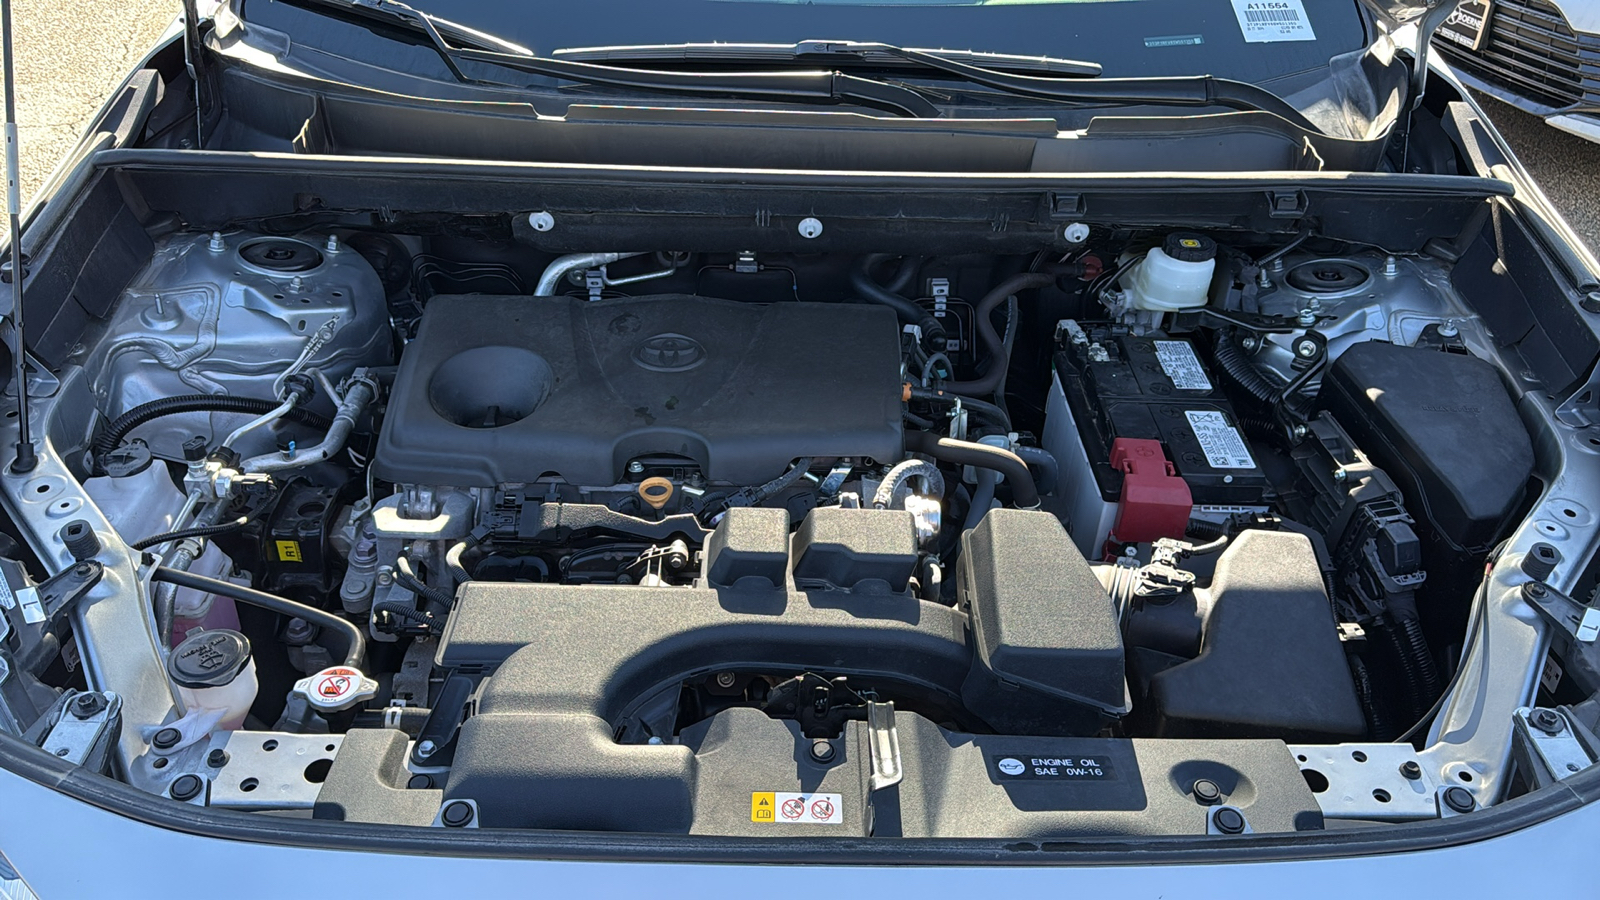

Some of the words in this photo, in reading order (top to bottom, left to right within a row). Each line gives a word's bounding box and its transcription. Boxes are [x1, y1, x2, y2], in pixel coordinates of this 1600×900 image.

[1031, 758, 1073, 767] ENGINE
[1080, 758, 1100, 767] OIL
[1034, 767, 1059, 776] SAE
[1066, 768, 1103, 776] 0W-16
